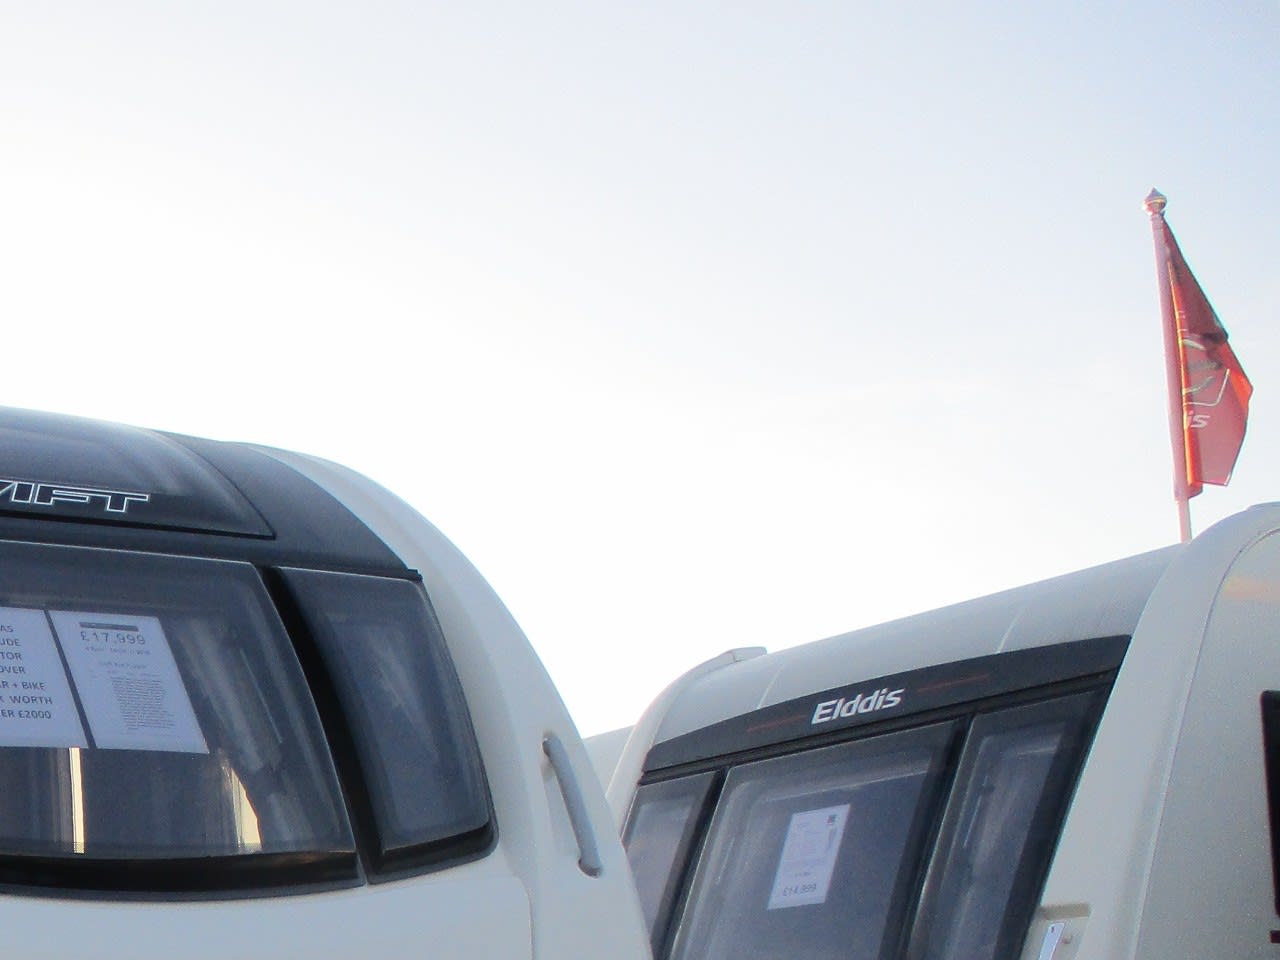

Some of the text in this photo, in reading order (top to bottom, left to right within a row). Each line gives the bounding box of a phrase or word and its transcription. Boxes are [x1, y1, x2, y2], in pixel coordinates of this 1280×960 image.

[21, 681, 47, 691] BIKE
[9, 695, 53, 705] WORTH
[811, 688, 906, 725] Elddis
[18, 709, 52, 720] £2000
